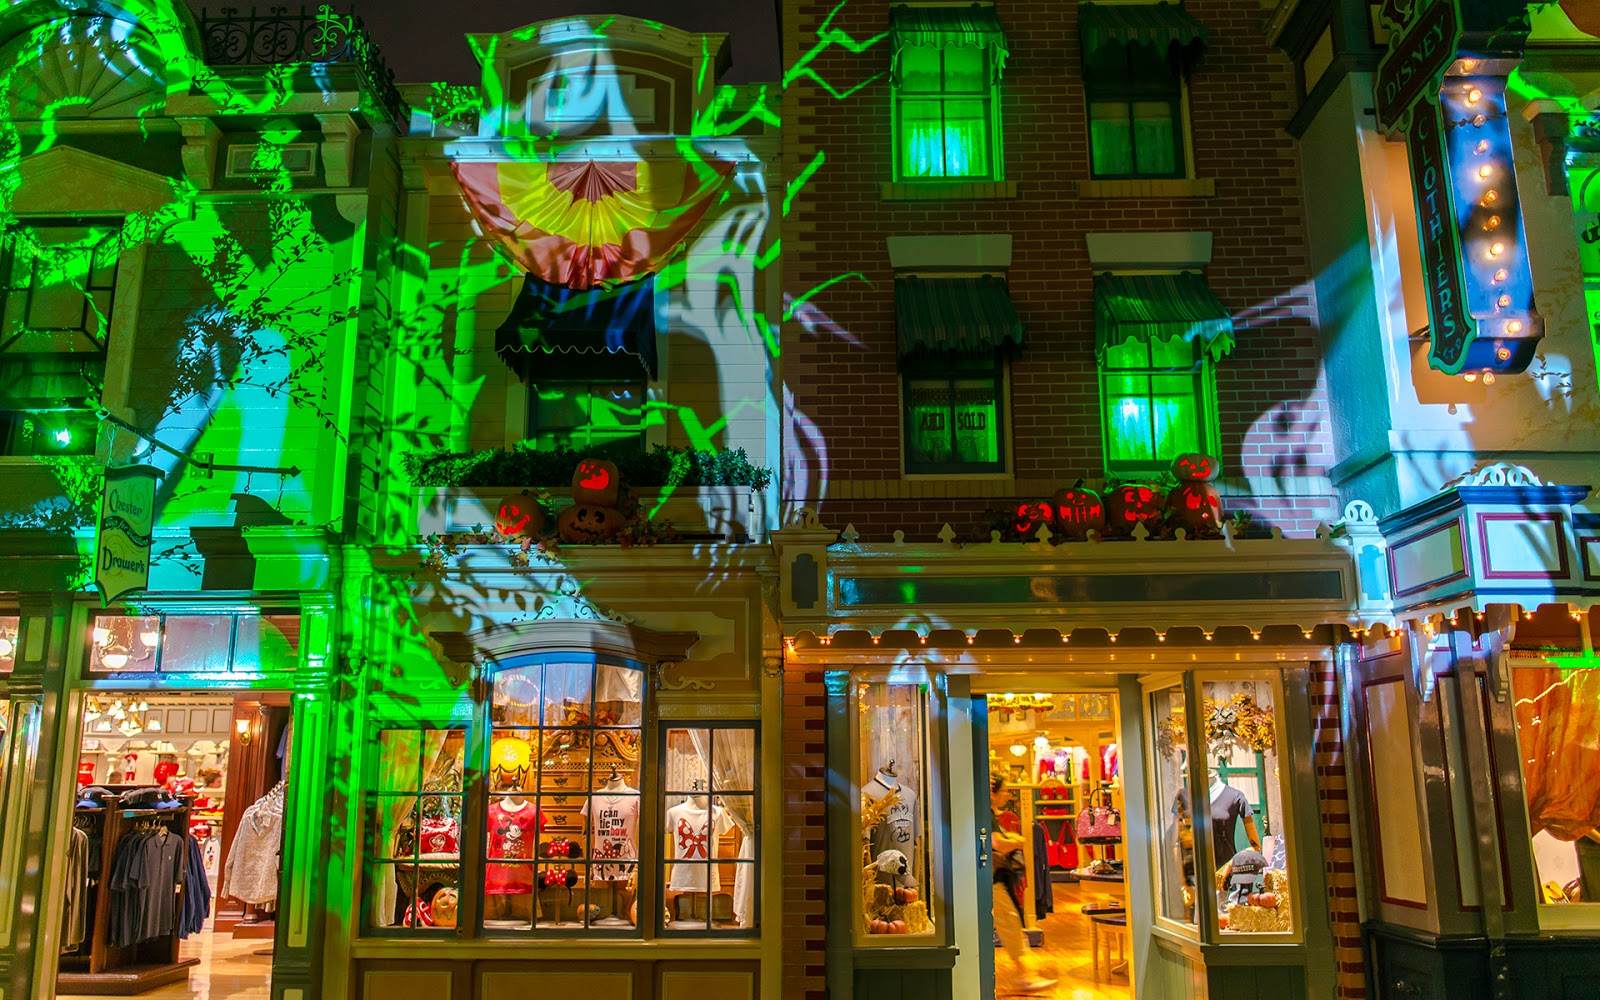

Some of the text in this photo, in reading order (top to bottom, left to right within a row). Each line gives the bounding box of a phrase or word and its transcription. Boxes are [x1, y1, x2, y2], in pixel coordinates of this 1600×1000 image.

[1385, 15, 1445, 104] DISNEY
[1418, 116, 1457, 339] CLOTHIERS
[920, 412, 986, 430] AND SOLD
[109, 489, 142, 517] Chester
[102, 546, 145, 573] Drawer's
[603, 810, 619, 818] can
[611, 818, 626, 828] my
